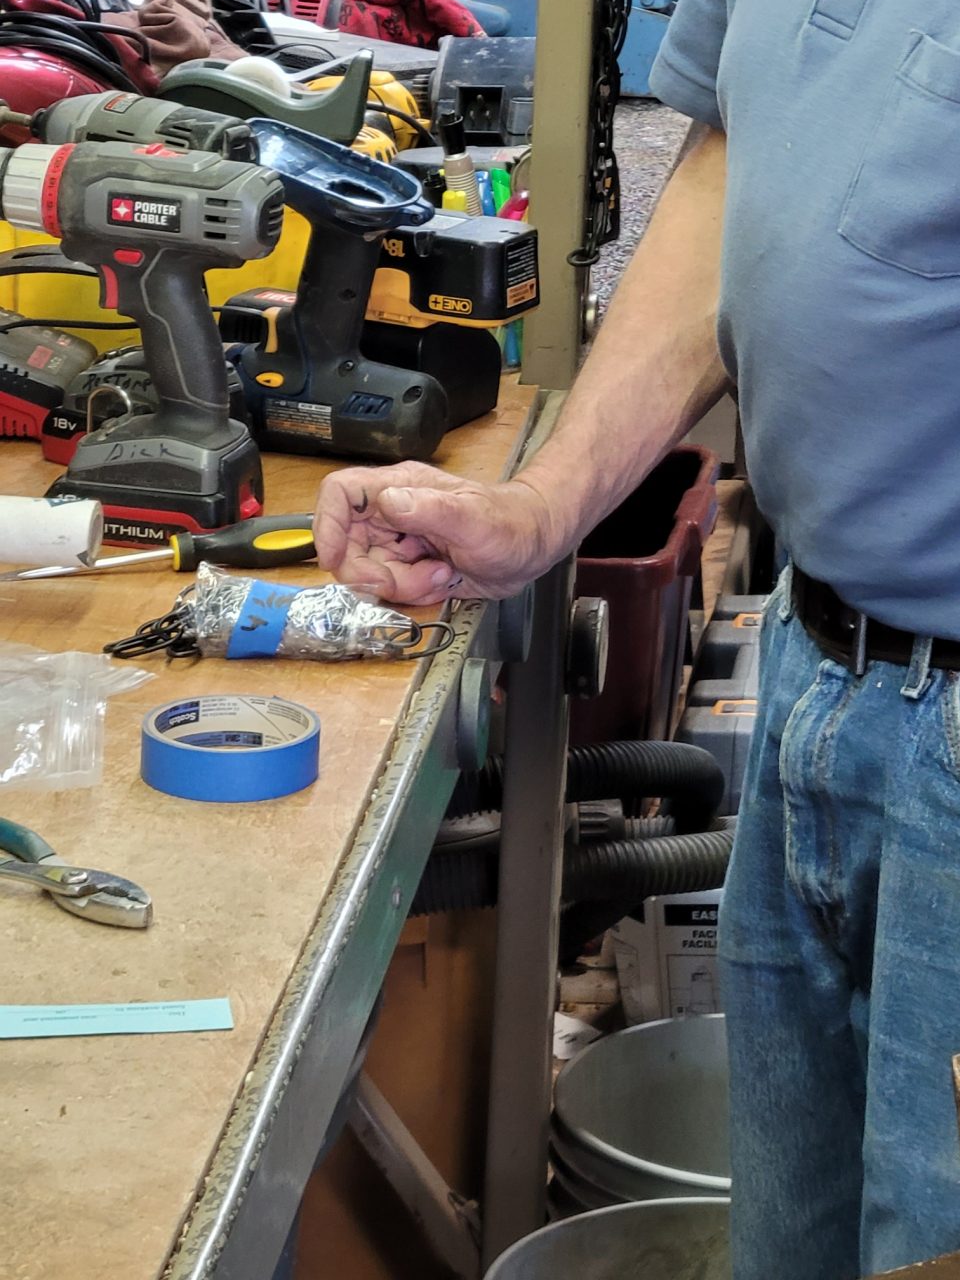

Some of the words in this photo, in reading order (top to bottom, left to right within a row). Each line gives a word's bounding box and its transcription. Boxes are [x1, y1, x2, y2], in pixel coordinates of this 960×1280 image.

[134, 201, 177, 216] PORTER
[134, 212, 168, 226] CABLE
[104, 523, 164, 539] ITHIUM
[691, 910, 718, 921] EAS
[692, 930, 717, 939] FAC
[682, 940, 717, 949] FACIL
